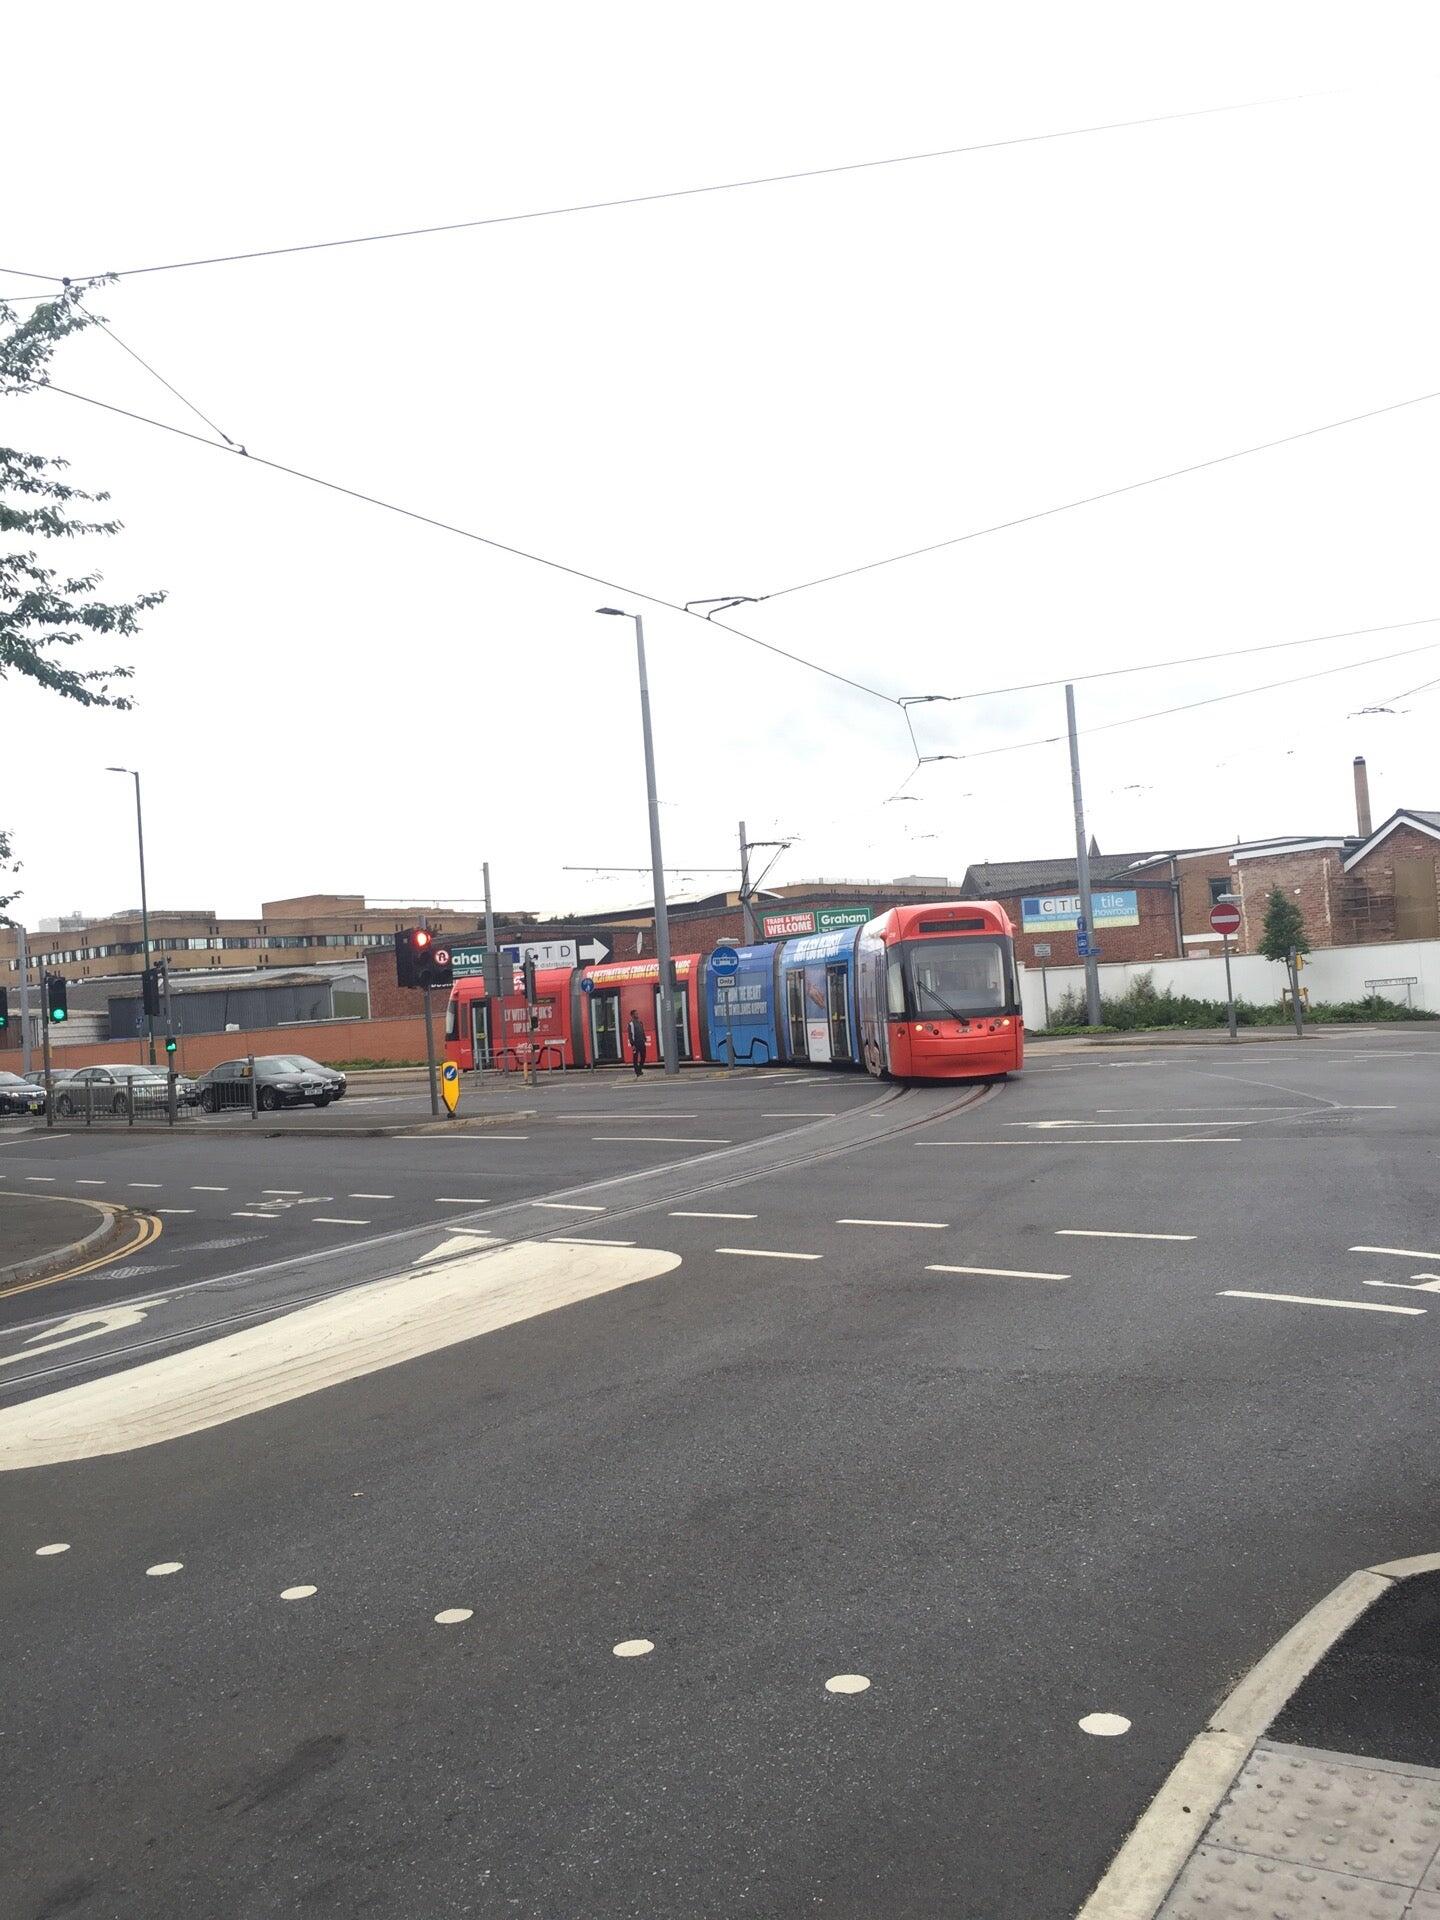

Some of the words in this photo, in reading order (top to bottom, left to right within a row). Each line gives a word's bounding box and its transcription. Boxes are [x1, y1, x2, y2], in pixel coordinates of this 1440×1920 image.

[1101, 895, 1124, 908] tile
[791, 914, 811, 922] PUBLIC
[821, 913, 866, 924] Graham
[767, 921, 812, 934] WELCOME
[512, 1008, 526, 1021] WITH
